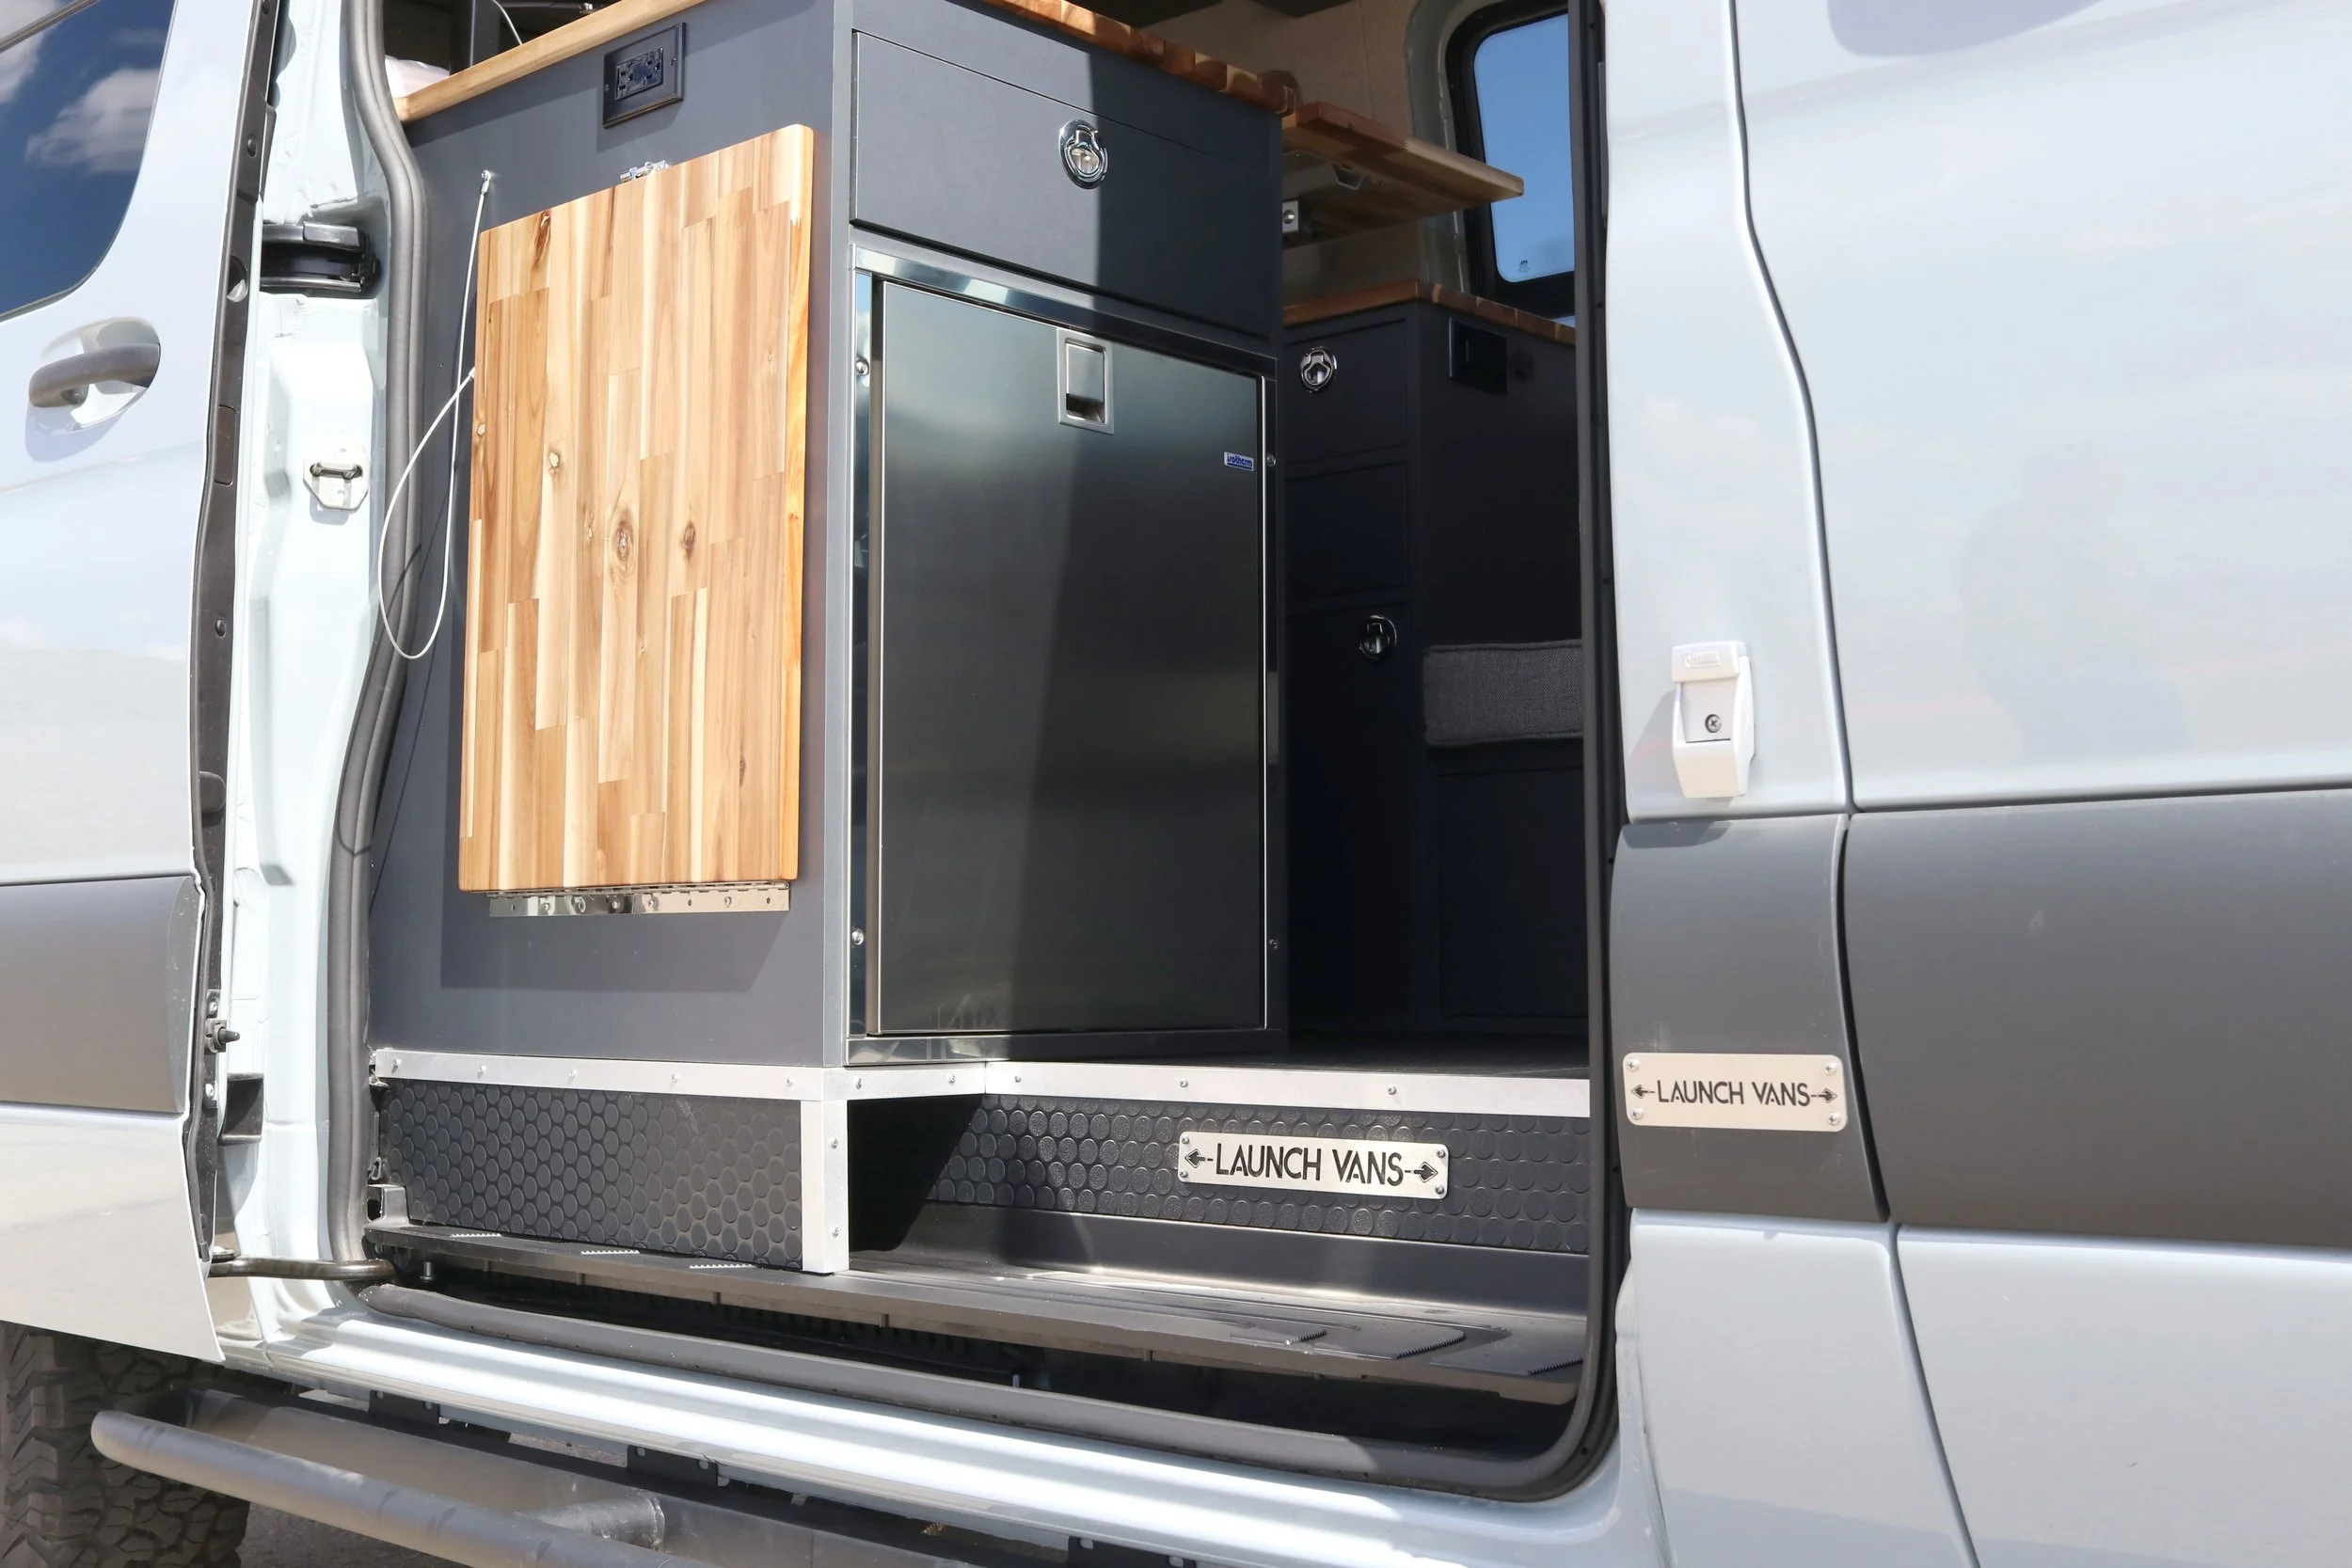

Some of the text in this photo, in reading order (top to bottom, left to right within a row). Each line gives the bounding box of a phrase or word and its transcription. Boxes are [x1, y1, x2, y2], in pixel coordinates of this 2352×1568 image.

[1657, 1080, 1811, 1107] LAUNCH VANS
[1216, 1143, 1404, 1186] LAUNCH VANS
